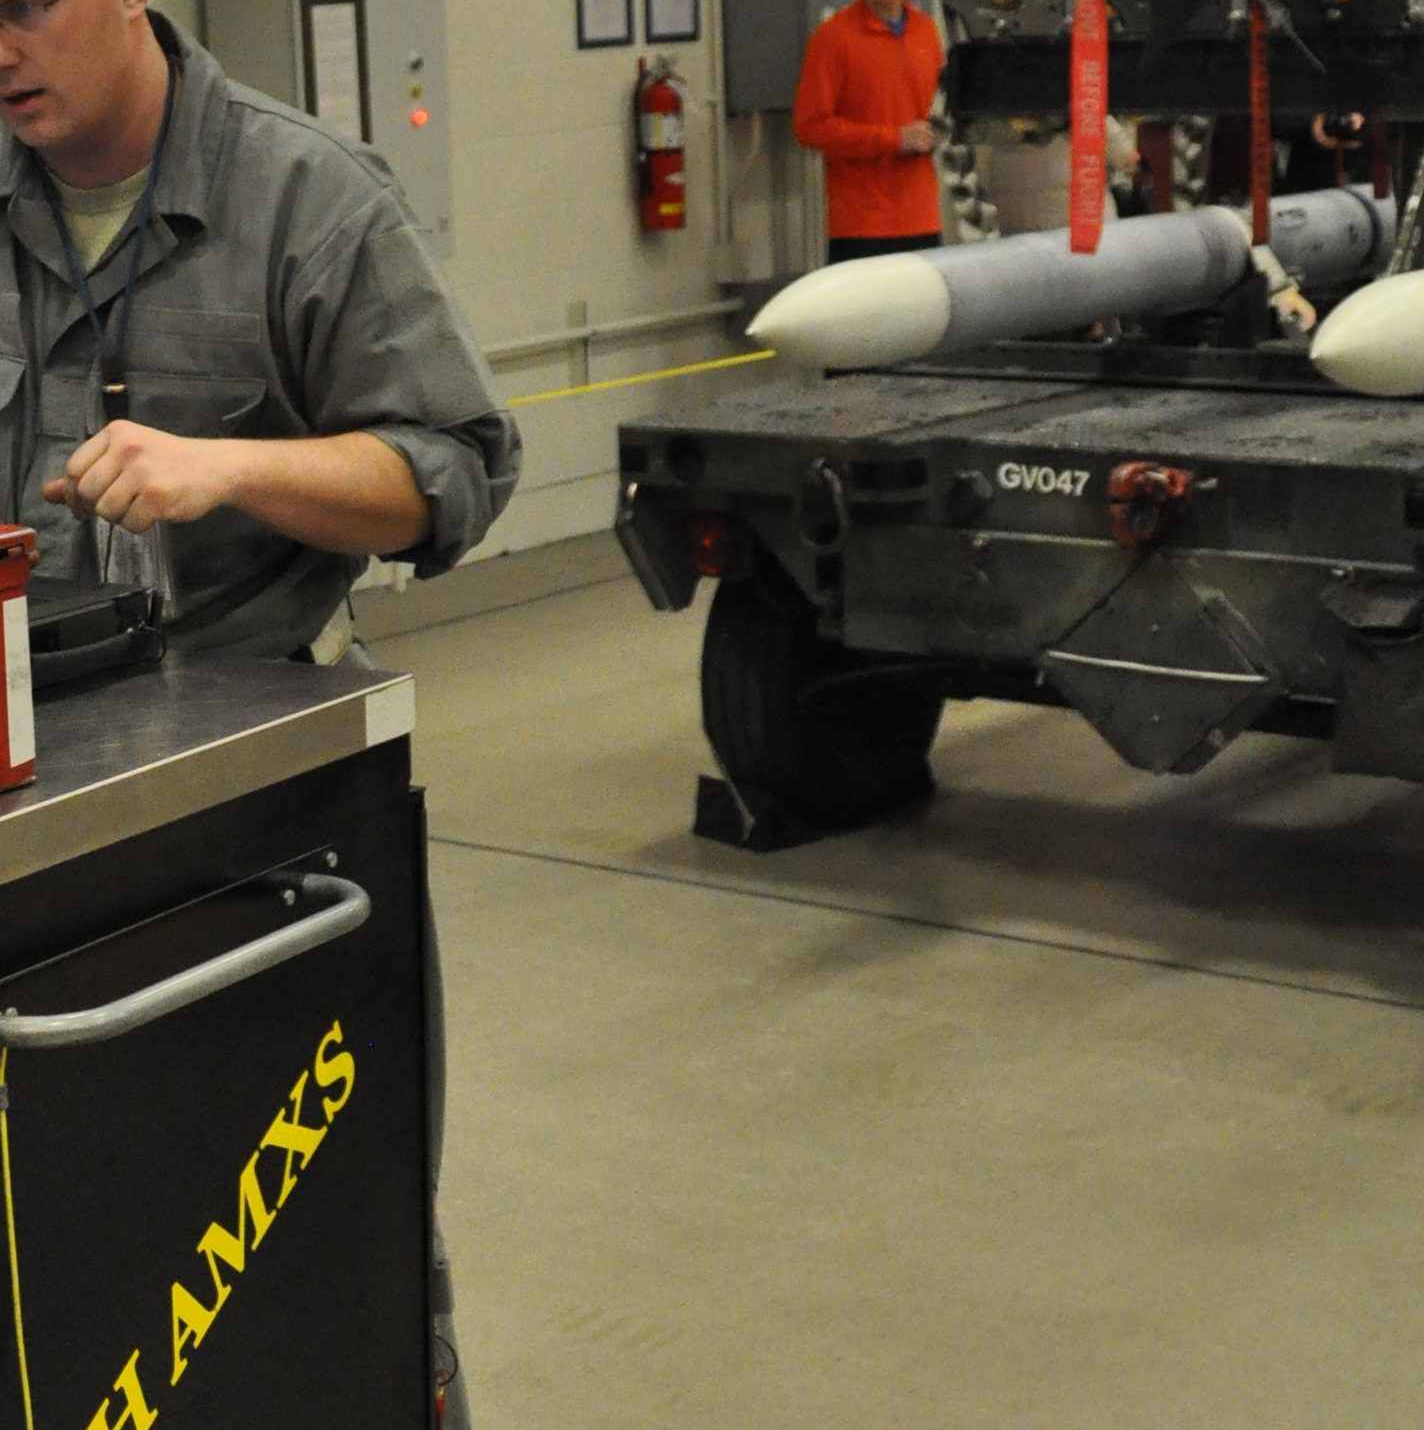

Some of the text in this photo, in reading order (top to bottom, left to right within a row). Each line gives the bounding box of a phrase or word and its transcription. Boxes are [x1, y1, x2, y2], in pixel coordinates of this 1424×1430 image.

[1081, 59, 1101, 136] BEFORE
[997, 462, 1090, 497] GV047
[170, 1020, 356, 1387] AMXS
